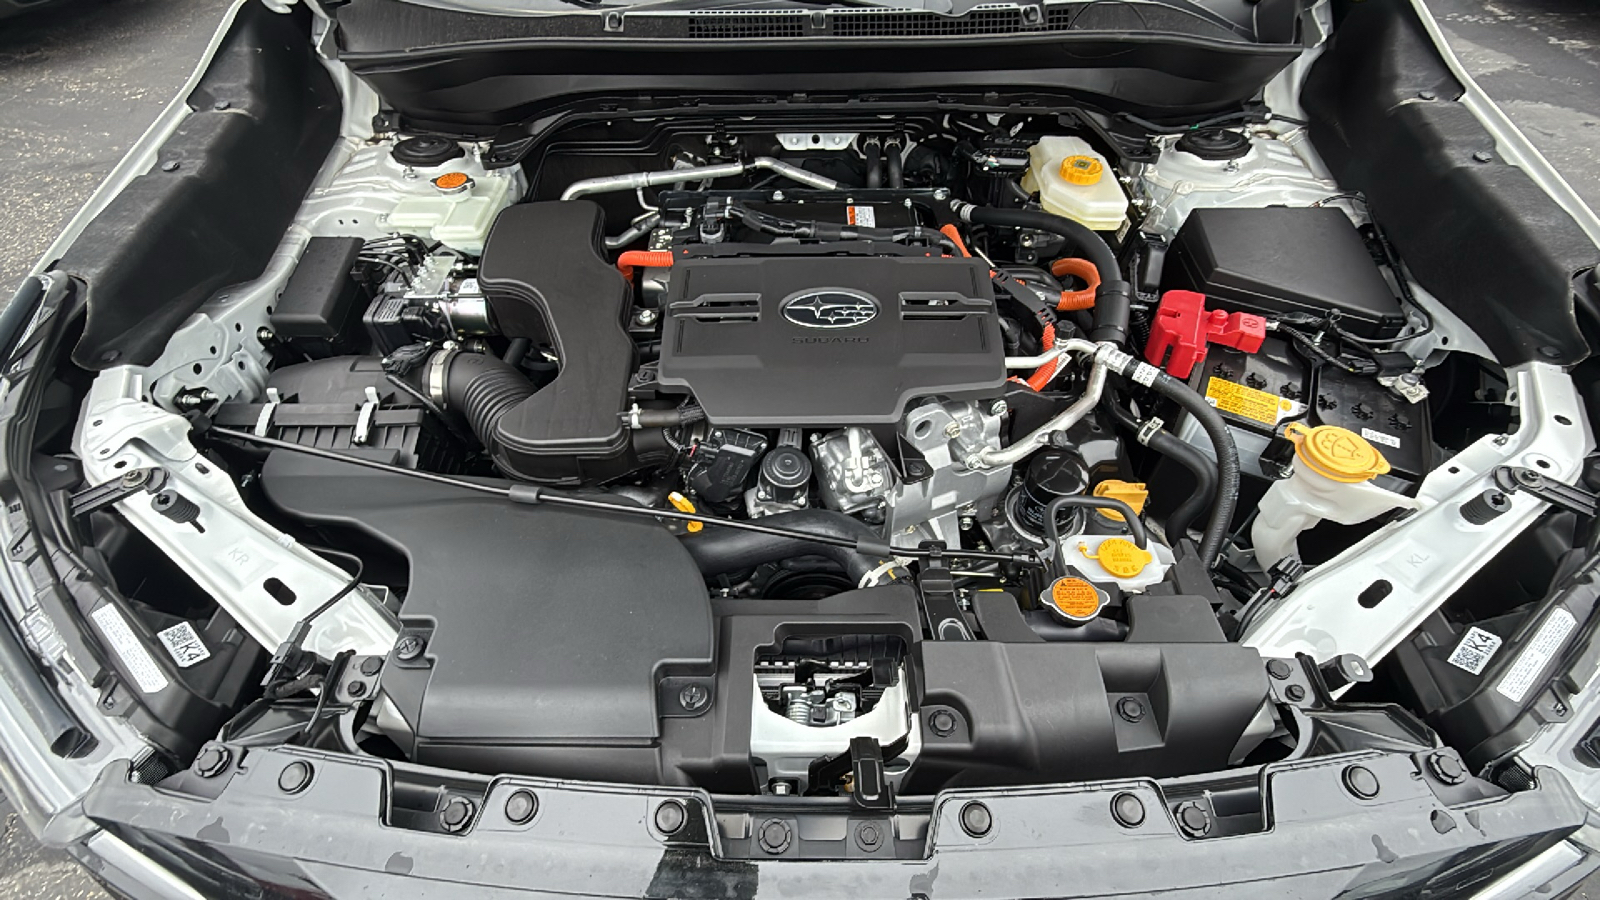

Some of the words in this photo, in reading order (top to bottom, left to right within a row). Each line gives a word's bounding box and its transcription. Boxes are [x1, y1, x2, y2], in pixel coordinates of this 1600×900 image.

[228, 547, 250, 565] KR
[1406, 553, 1430, 568] KL
[179, 641, 200, 662] K4
[1467, 633, 1493, 652] K4
